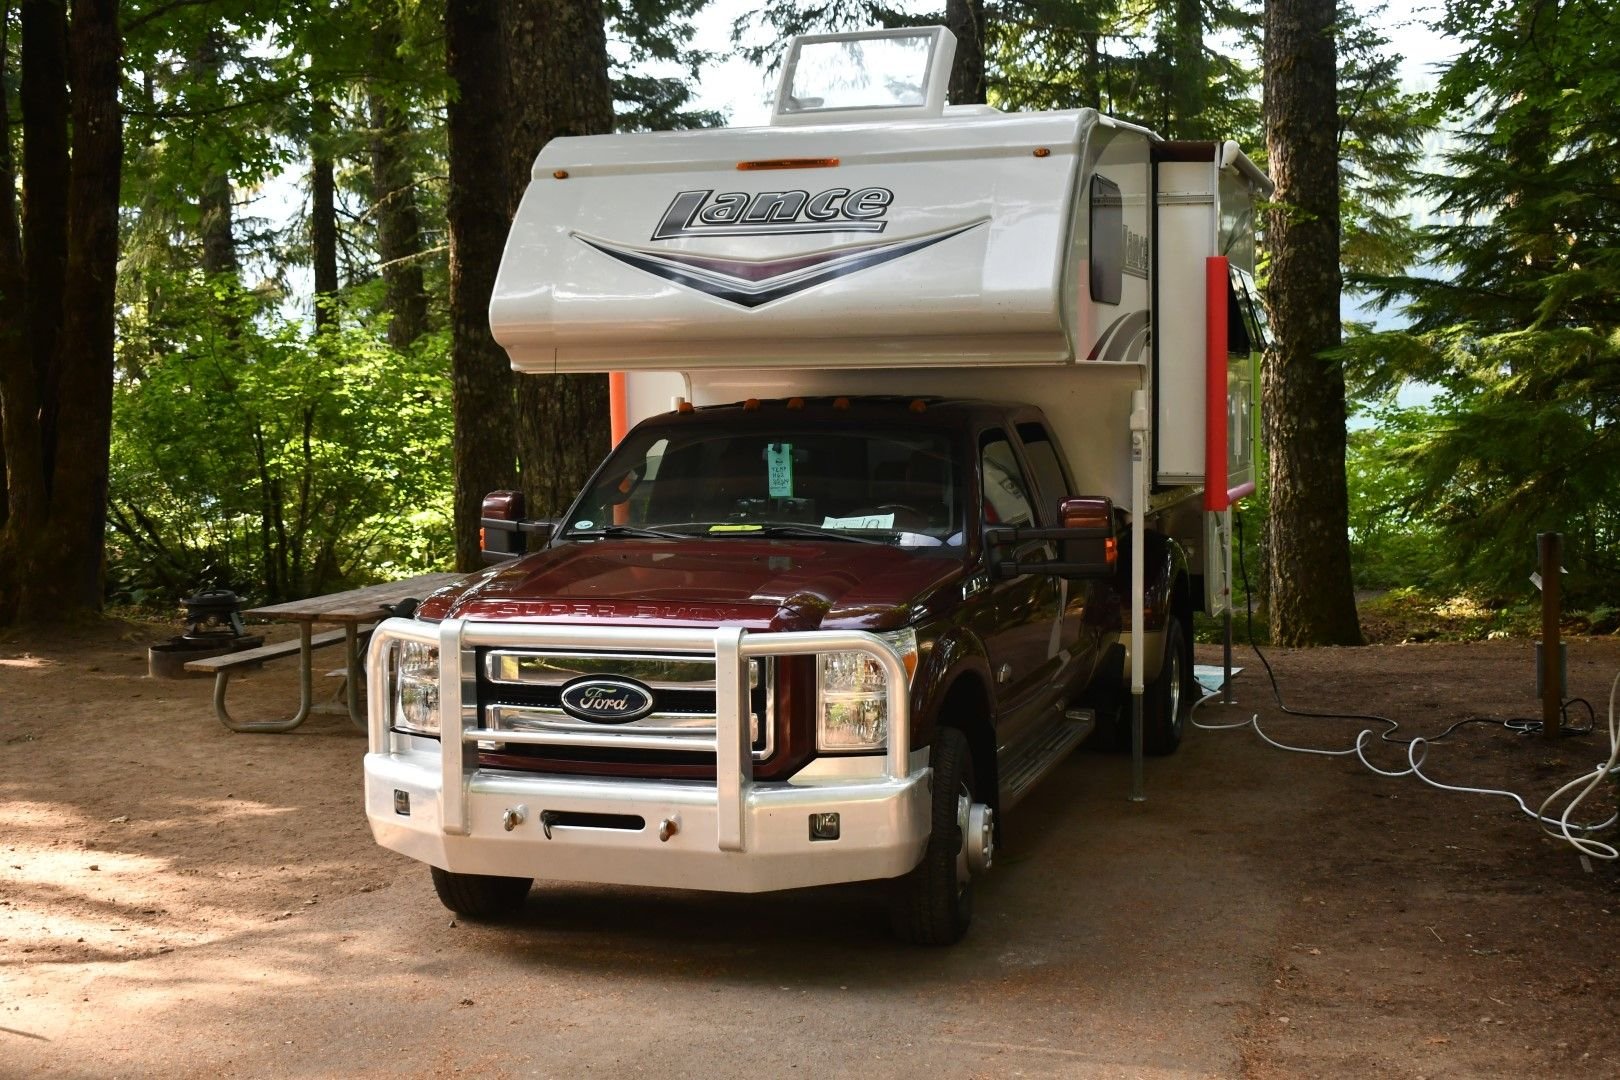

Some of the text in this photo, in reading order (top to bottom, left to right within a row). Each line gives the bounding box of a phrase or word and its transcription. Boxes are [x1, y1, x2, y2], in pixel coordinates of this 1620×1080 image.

[650, 186, 894, 241] Lance
[496, 603, 738, 620] SUPER DUTY
[579, 686, 629, 711] Ford
